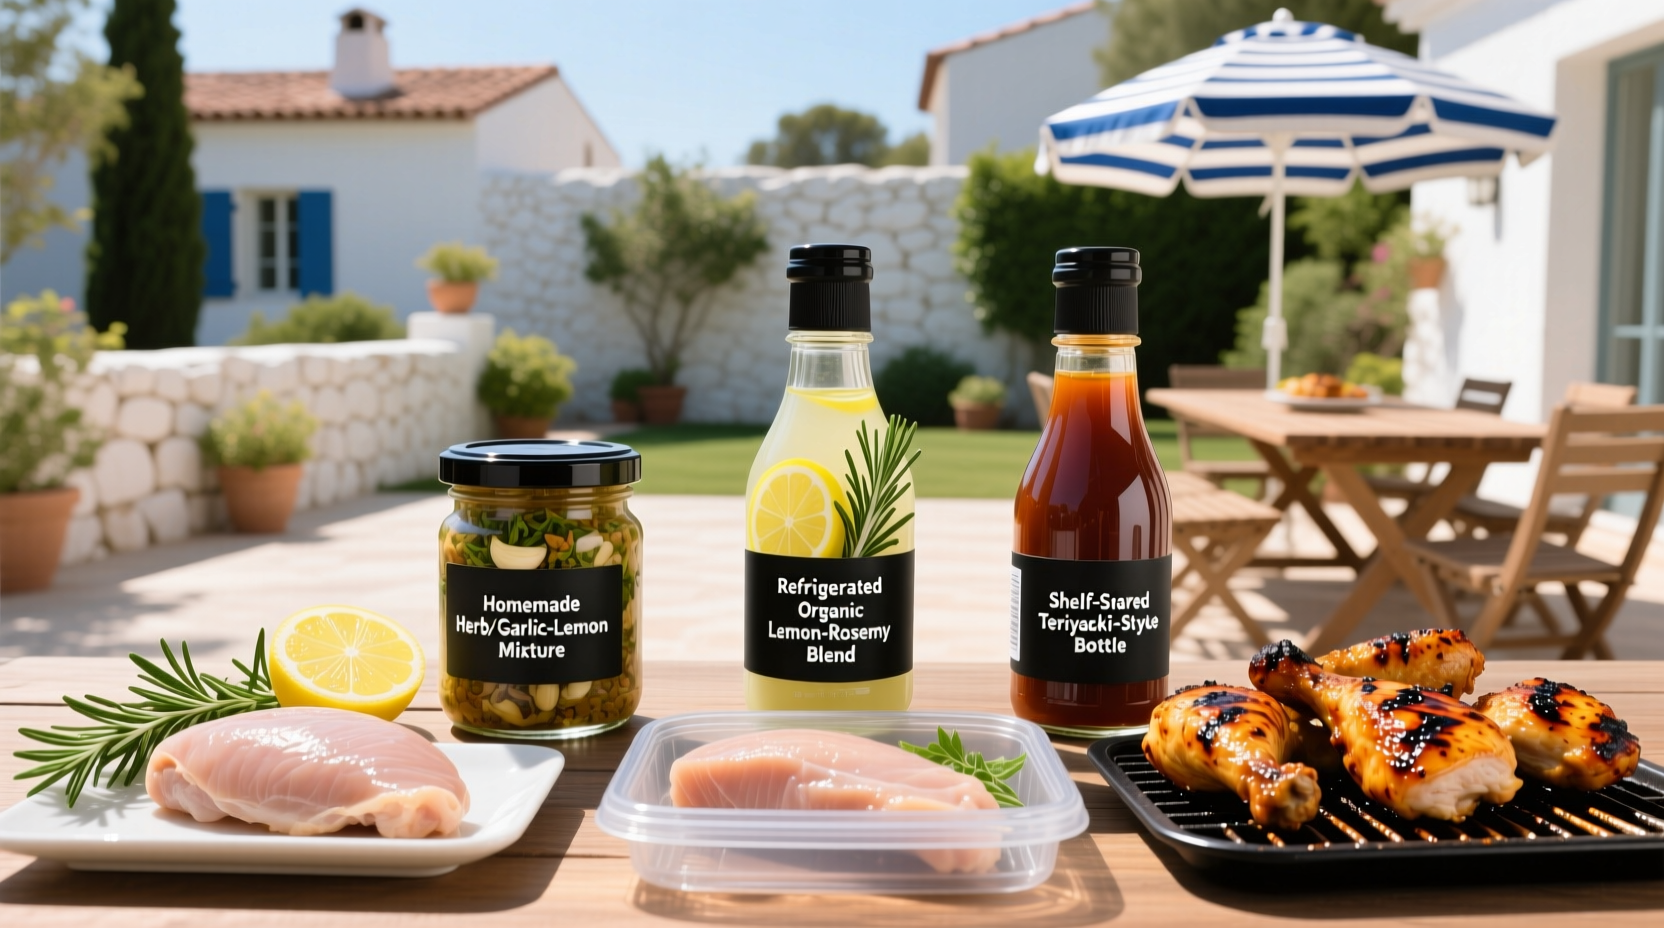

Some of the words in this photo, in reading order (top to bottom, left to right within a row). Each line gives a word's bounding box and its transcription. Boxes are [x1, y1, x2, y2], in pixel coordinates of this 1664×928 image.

[777, 576, 883, 601] Refrigerated
[483, 594, 581, 613] Homemade
[798, 601, 864, 623] Organic
[456, 615, 609, 636] Herb/Garlic-Lemon
[768, 620, 891, 643] Lemon-Rosemy
[498, 641, 566, 659] Mixture
[806, 644, 856, 663] Blend
[1074, 636, 1127, 654] Bottle
